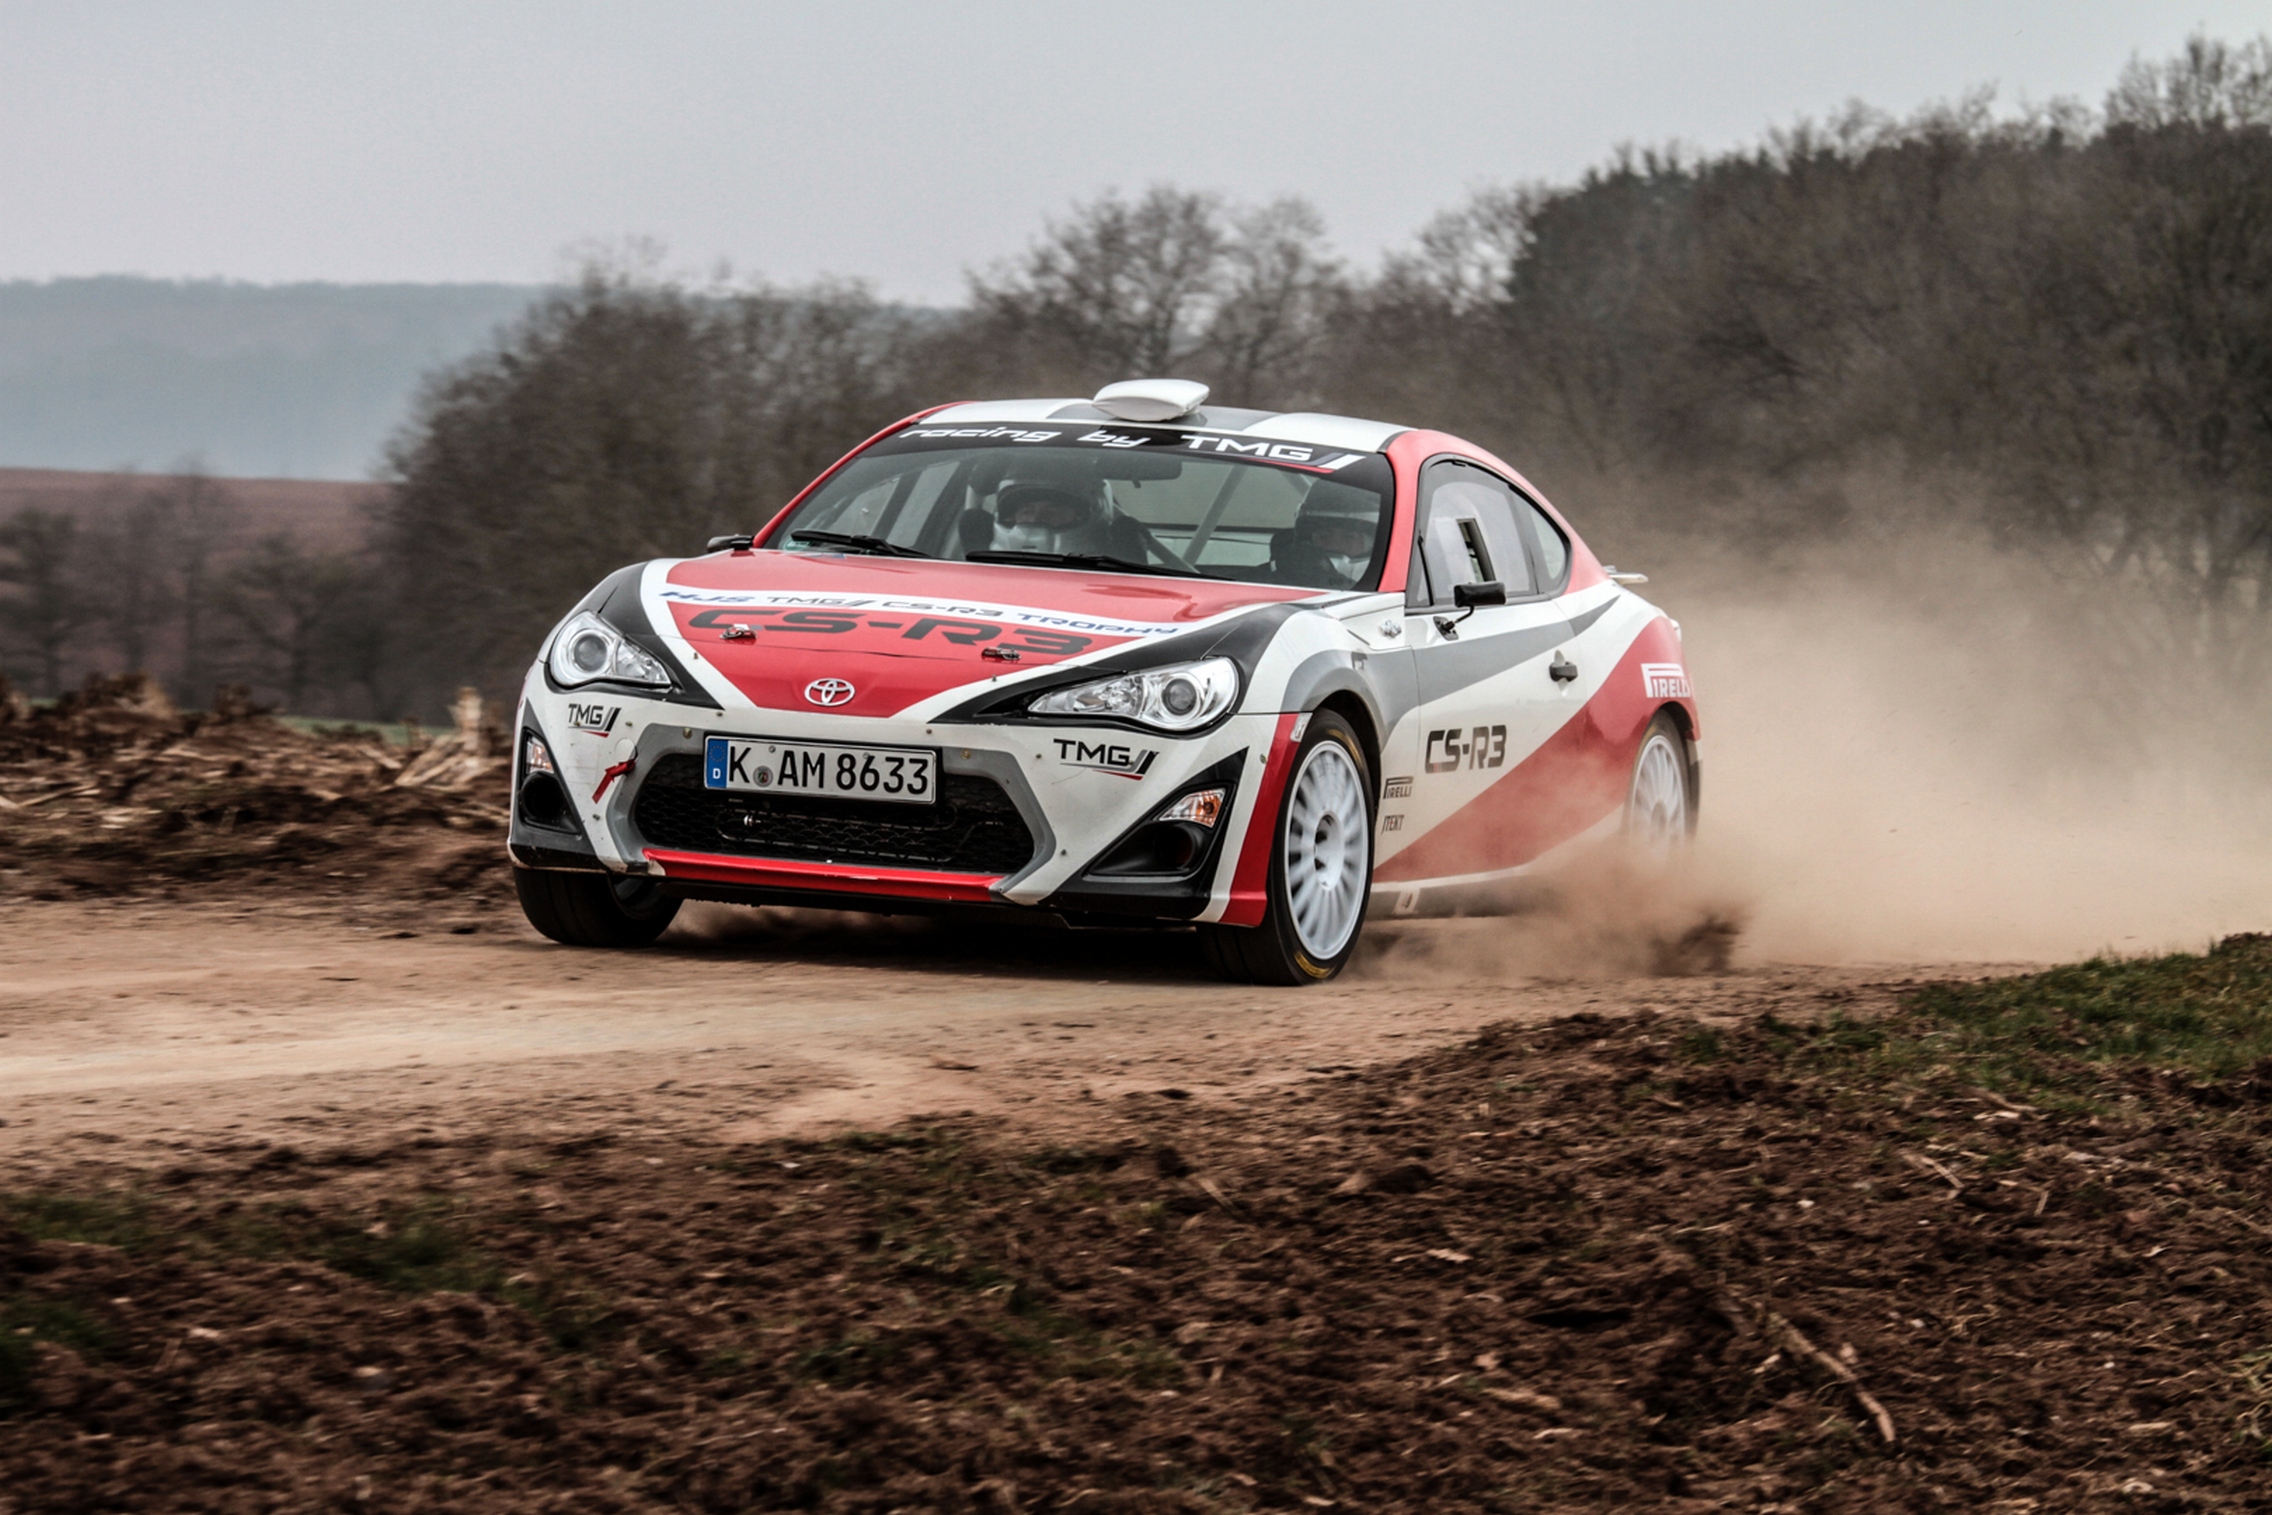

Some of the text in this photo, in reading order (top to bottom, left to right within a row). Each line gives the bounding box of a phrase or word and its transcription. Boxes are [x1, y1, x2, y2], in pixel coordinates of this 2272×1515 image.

[898, 426, 1314, 462] racing by TMG
[659, 591, 1179, 634] HJS TMG CS-R3 TROPHY
[688, 609, 1093, 656] CS-R3
[568, 703, 604, 726] TMG
[1053, 737, 1132, 767] TMG
[1425, 724, 1508, 774] CS-R3
[712, 768, 722, 780] D
[728, 745, 929, 795] K AM 8633
[1383, 776, 1415, 800] PIRELLI
